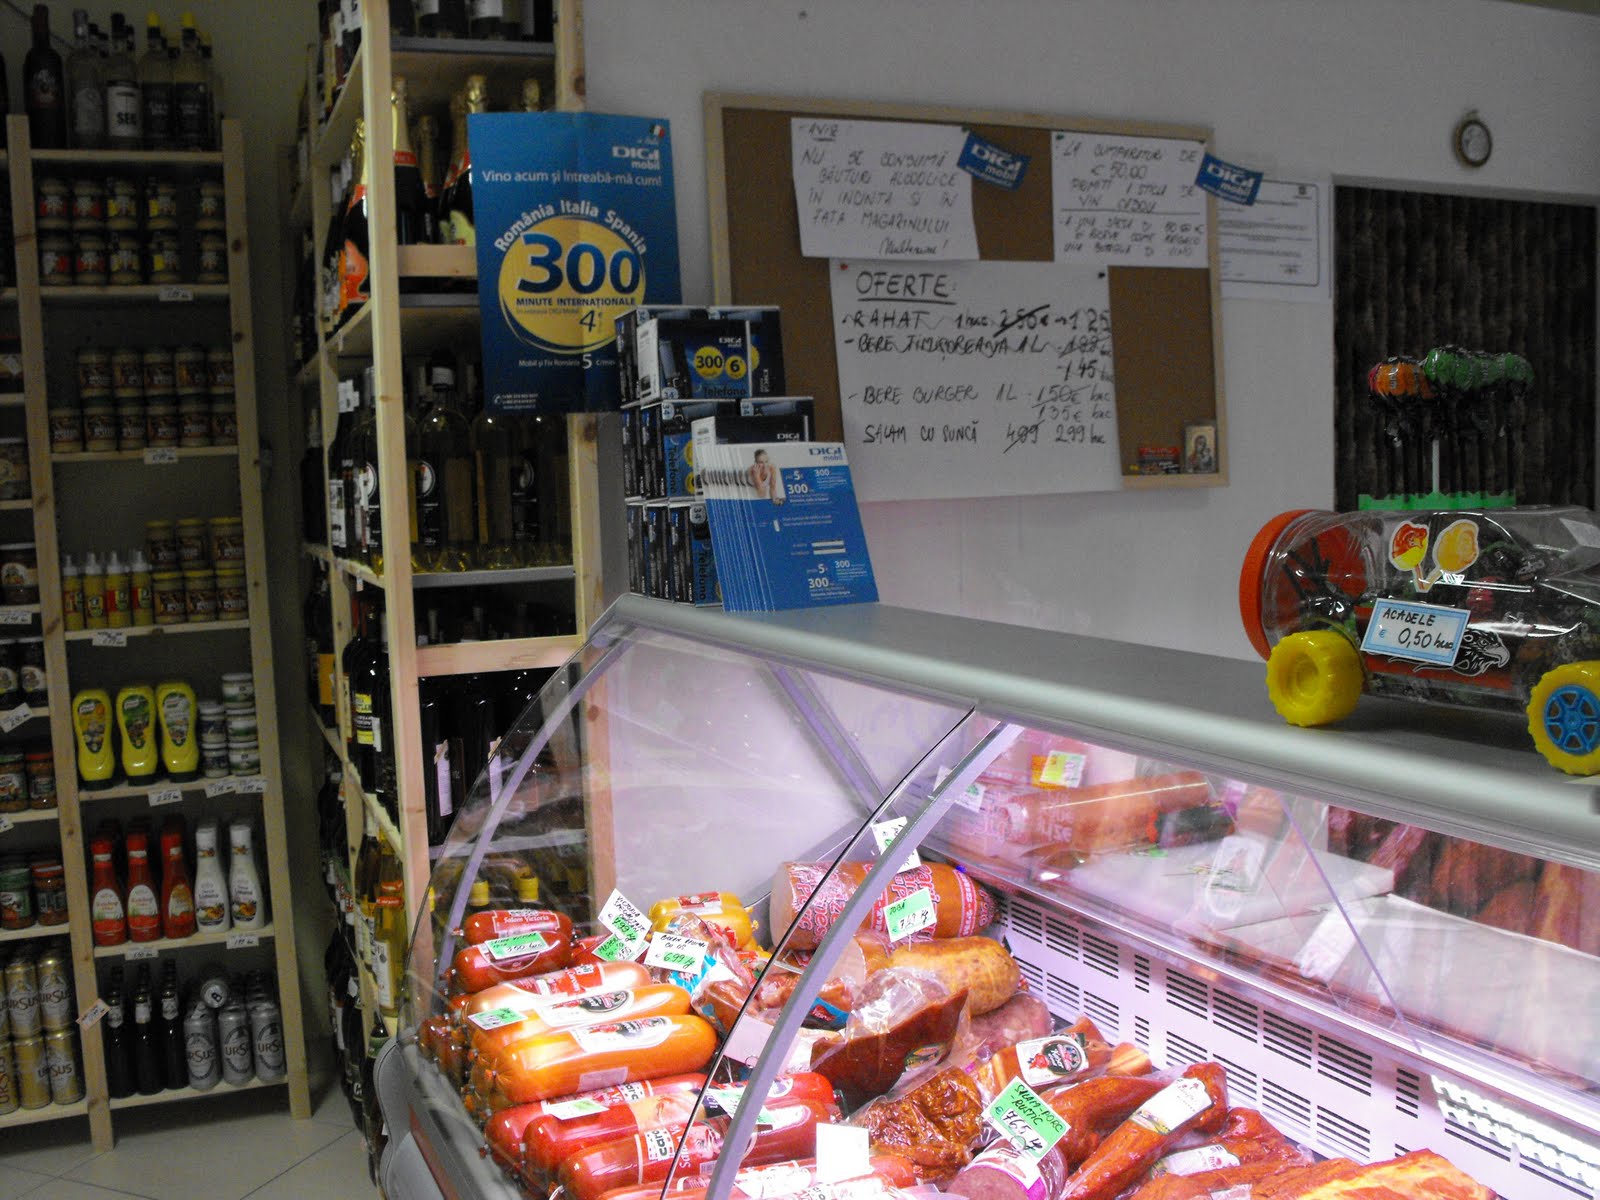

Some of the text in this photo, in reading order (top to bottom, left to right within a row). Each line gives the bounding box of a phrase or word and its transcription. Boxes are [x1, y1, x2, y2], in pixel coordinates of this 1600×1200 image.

[612, 146, 660, 161] DIGI
[802, 147, 825, 164] NU
[971, 143, 1022, 172] DIGI
[631, 159, 660, 170] mobil
[482, 170, 511, 182] Vino
[514, 172, 549, 182] acum
[635, 174, 662, 187] cum!
[1207, 163, 1255, 187] DIGI
[493, 199, 648, 254] România Italia Spania
[517, 231, 641, 294] 300
[516, 297, 553, 306] MINUTE
[853, 308, 930, 329] RAHAT
[859, 333, 893, 353] BERE
[582, 353, 593, 369] 5
[696, 355, 741, 373] 300 6
[864, 384, 901, 405] BERE
[808, 448, 843, 456] DIGI
[814, 469, 830, 477] 300
[788, 484, 808, 494] 300
[835, 560, 850, 568] 300
[809, 578, 829, 587] 300
[1383, 607, 1436, 627] ACADELE
[1398, 627, 1432, 648] 0,50
